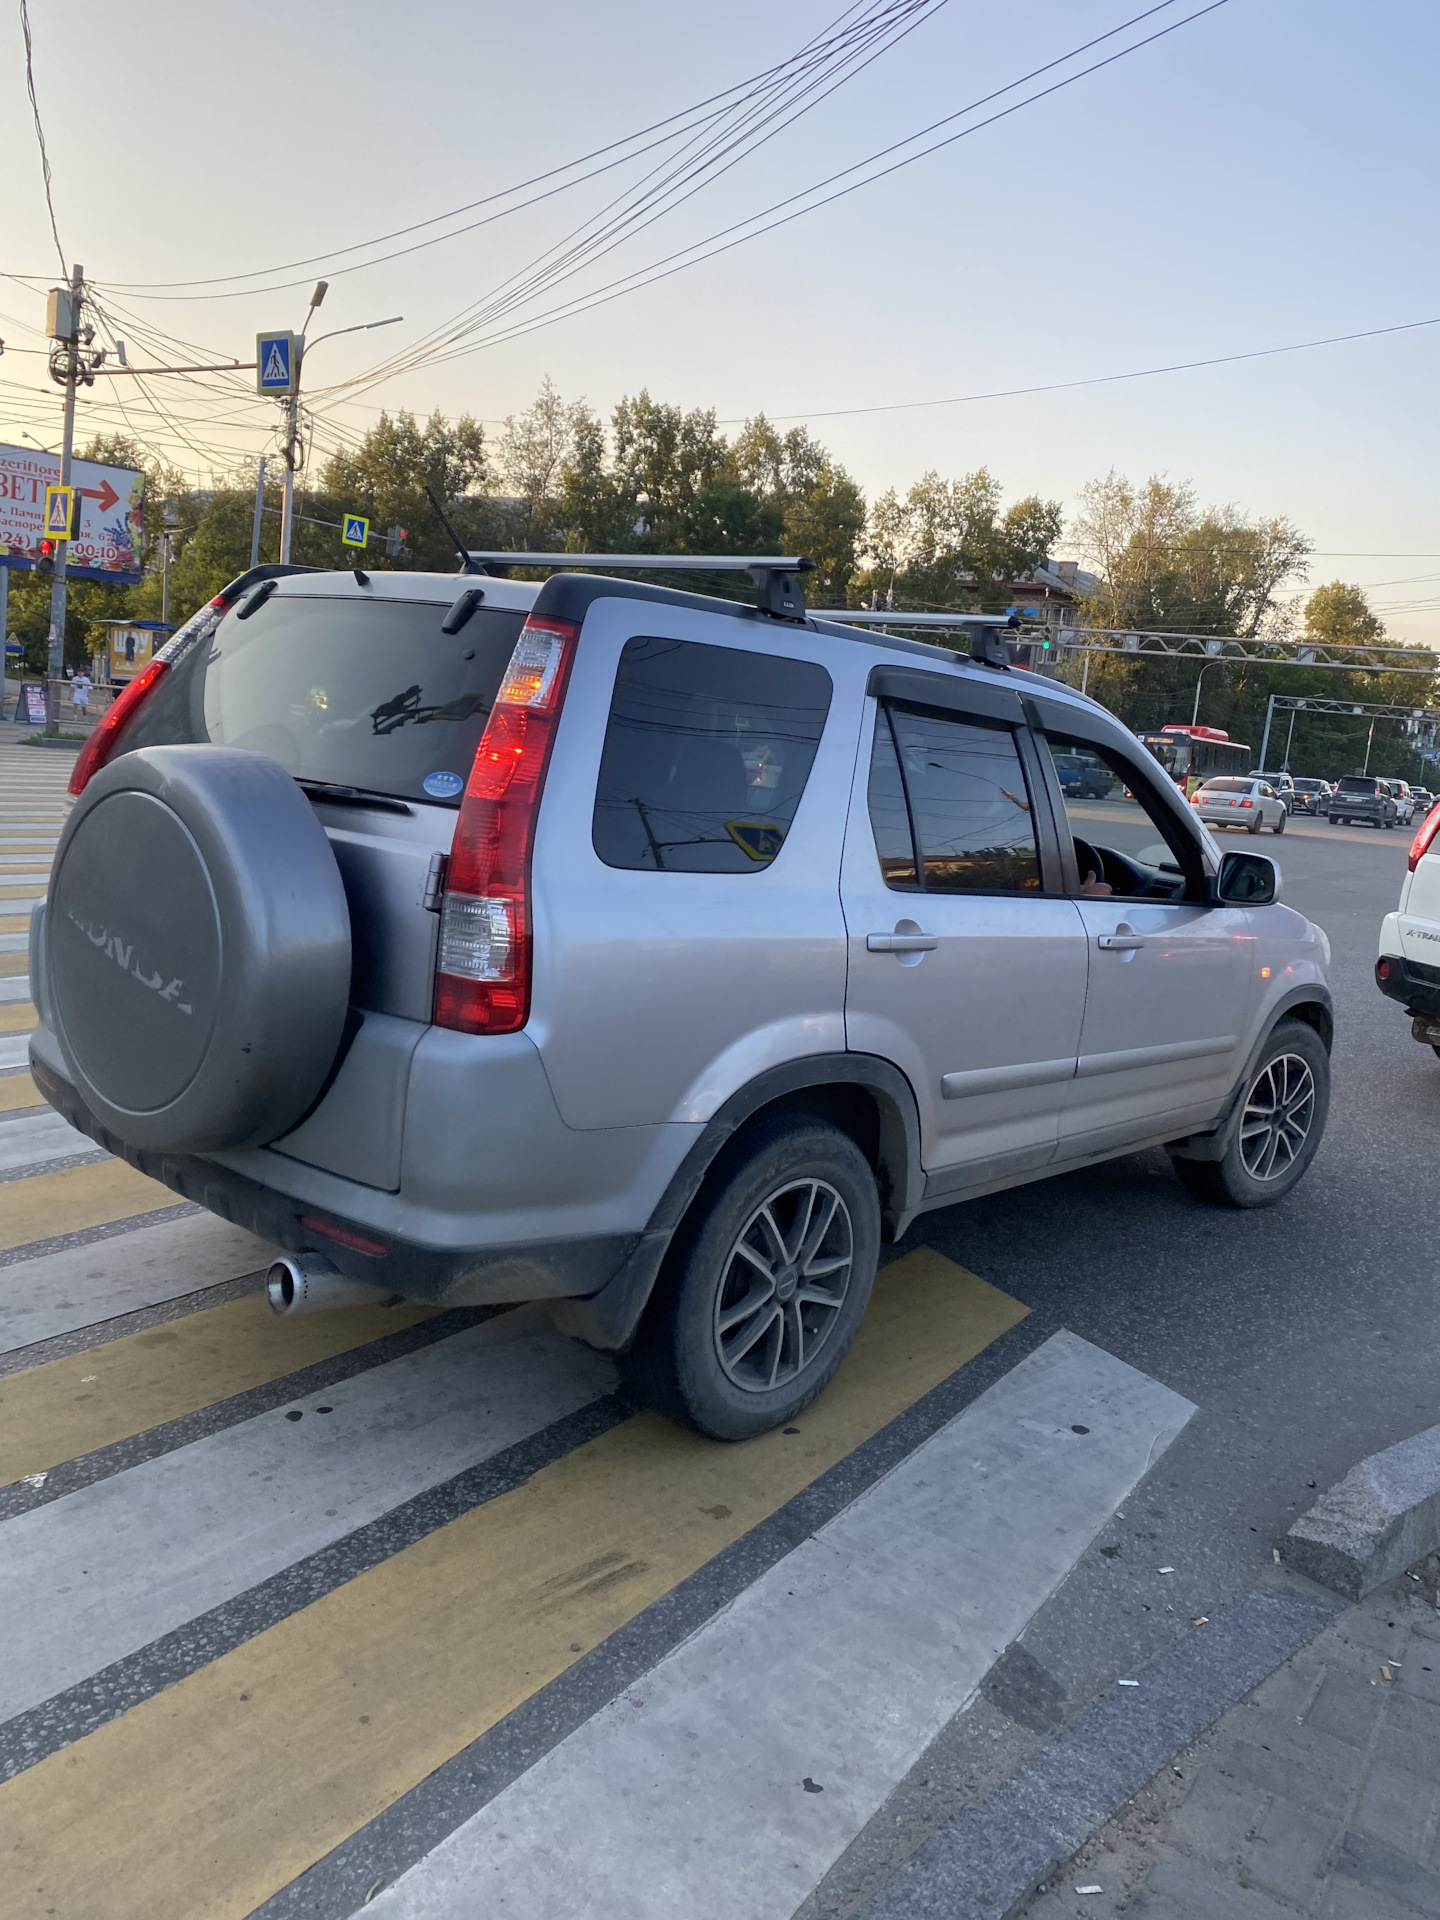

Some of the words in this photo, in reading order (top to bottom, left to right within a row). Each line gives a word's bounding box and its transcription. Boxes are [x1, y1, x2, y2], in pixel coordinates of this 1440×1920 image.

[0, 472, 52, 505] ВЕТ
[0, 531, 31, 549] 24)
[1406, 929, 1440, 943] X-TRAI
